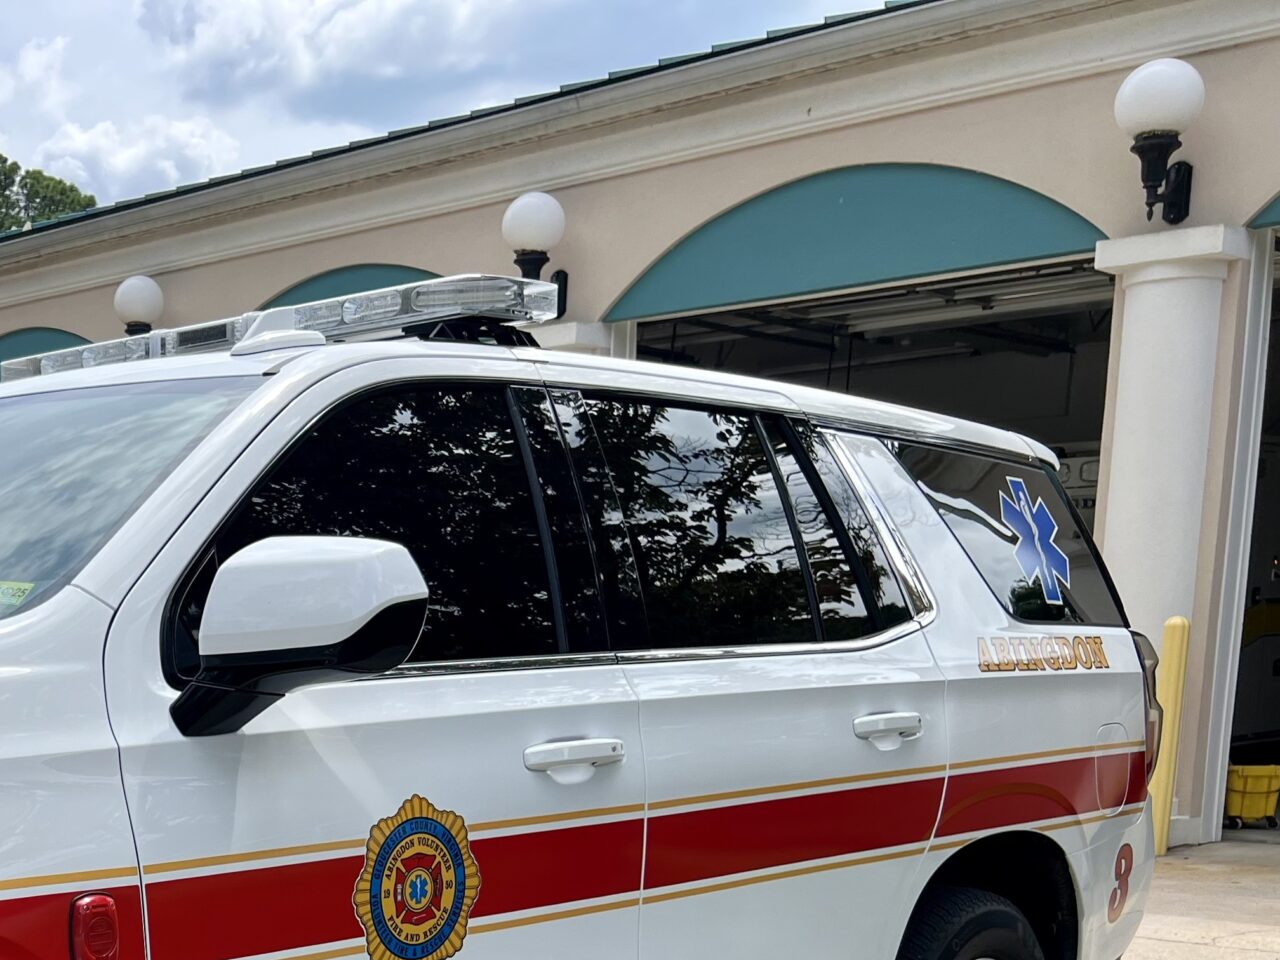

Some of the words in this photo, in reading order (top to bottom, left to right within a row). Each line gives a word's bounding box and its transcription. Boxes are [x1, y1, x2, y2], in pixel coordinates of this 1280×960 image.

[11, 587, 29, 598] 25
[977, 636, 1109, 672] ABINGDON
[374, 826, 407, 879] GLOUCESTER
[410, 821, 437, 834] COUNTY
[441, 831, 462, 868] VIRGINIA
[385, 838, 415, 880] ABINGDON
[417, 836, 452, 872] VOLUNTEER
[383, 889, 390, 898] 19
[387, 915, 403, 937] FIRE
[404, 933, 420, 942] AND
[422, 906, 449, 939] RESCUE
